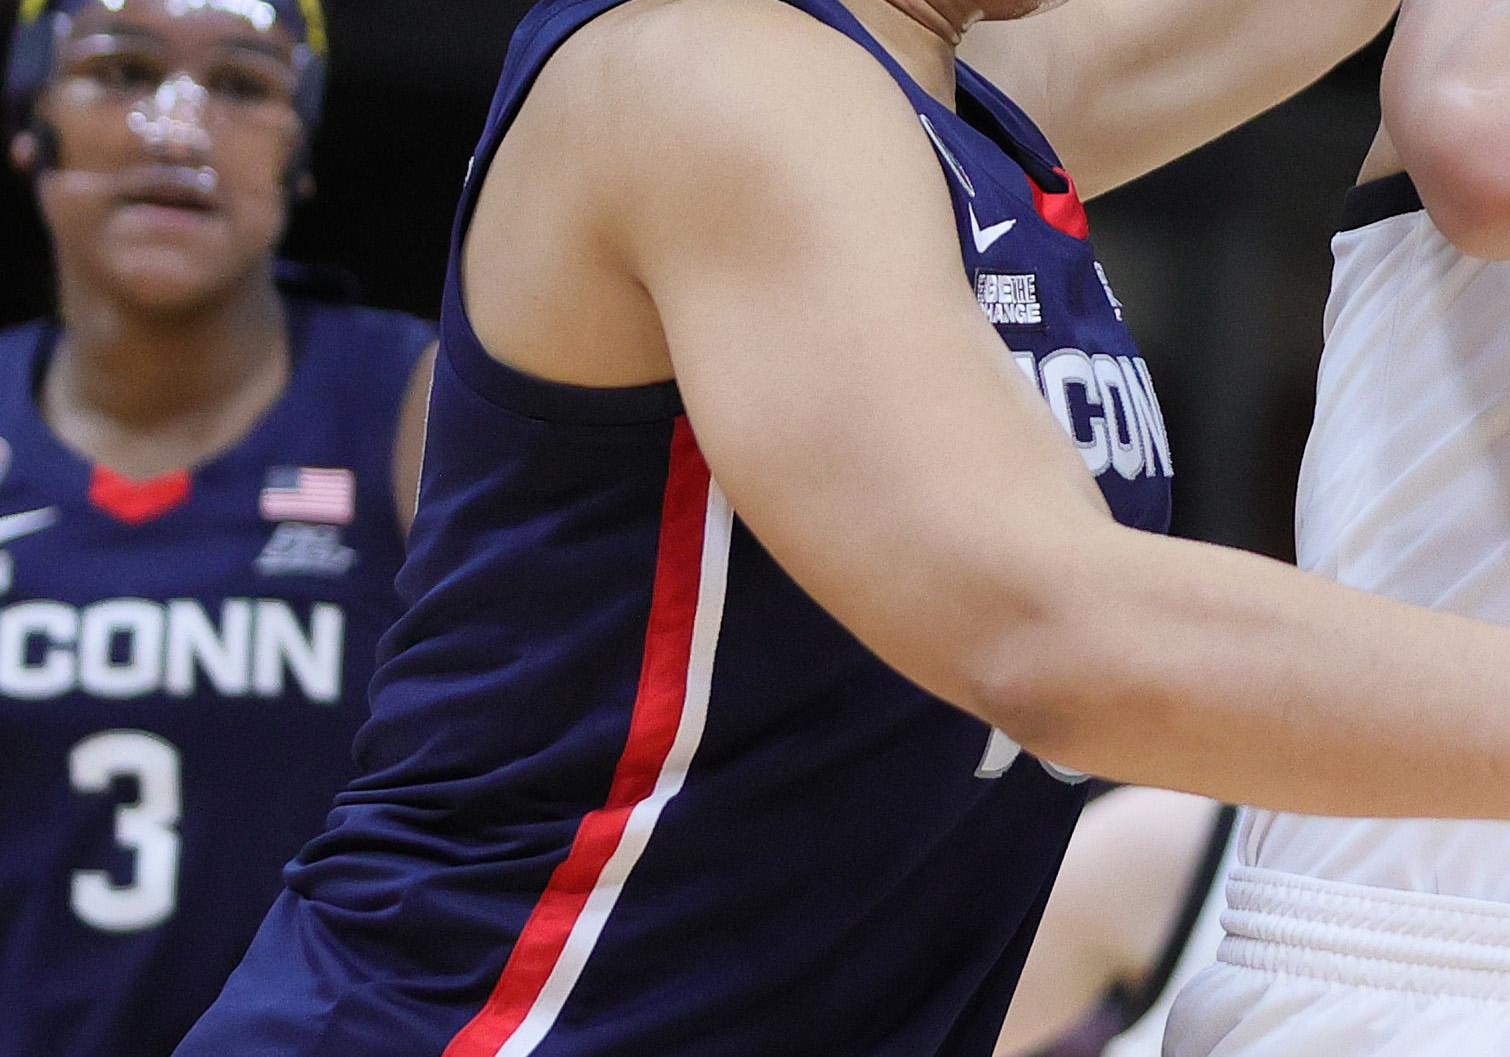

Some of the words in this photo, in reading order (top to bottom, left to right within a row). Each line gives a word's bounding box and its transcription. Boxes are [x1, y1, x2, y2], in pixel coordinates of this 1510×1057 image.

[985, 274, 1012, 303] BE
[1010, 274, 1036, 303] THE
[1010, 348, 1174, 480] CON
[69, 728, 182, 933] 3
